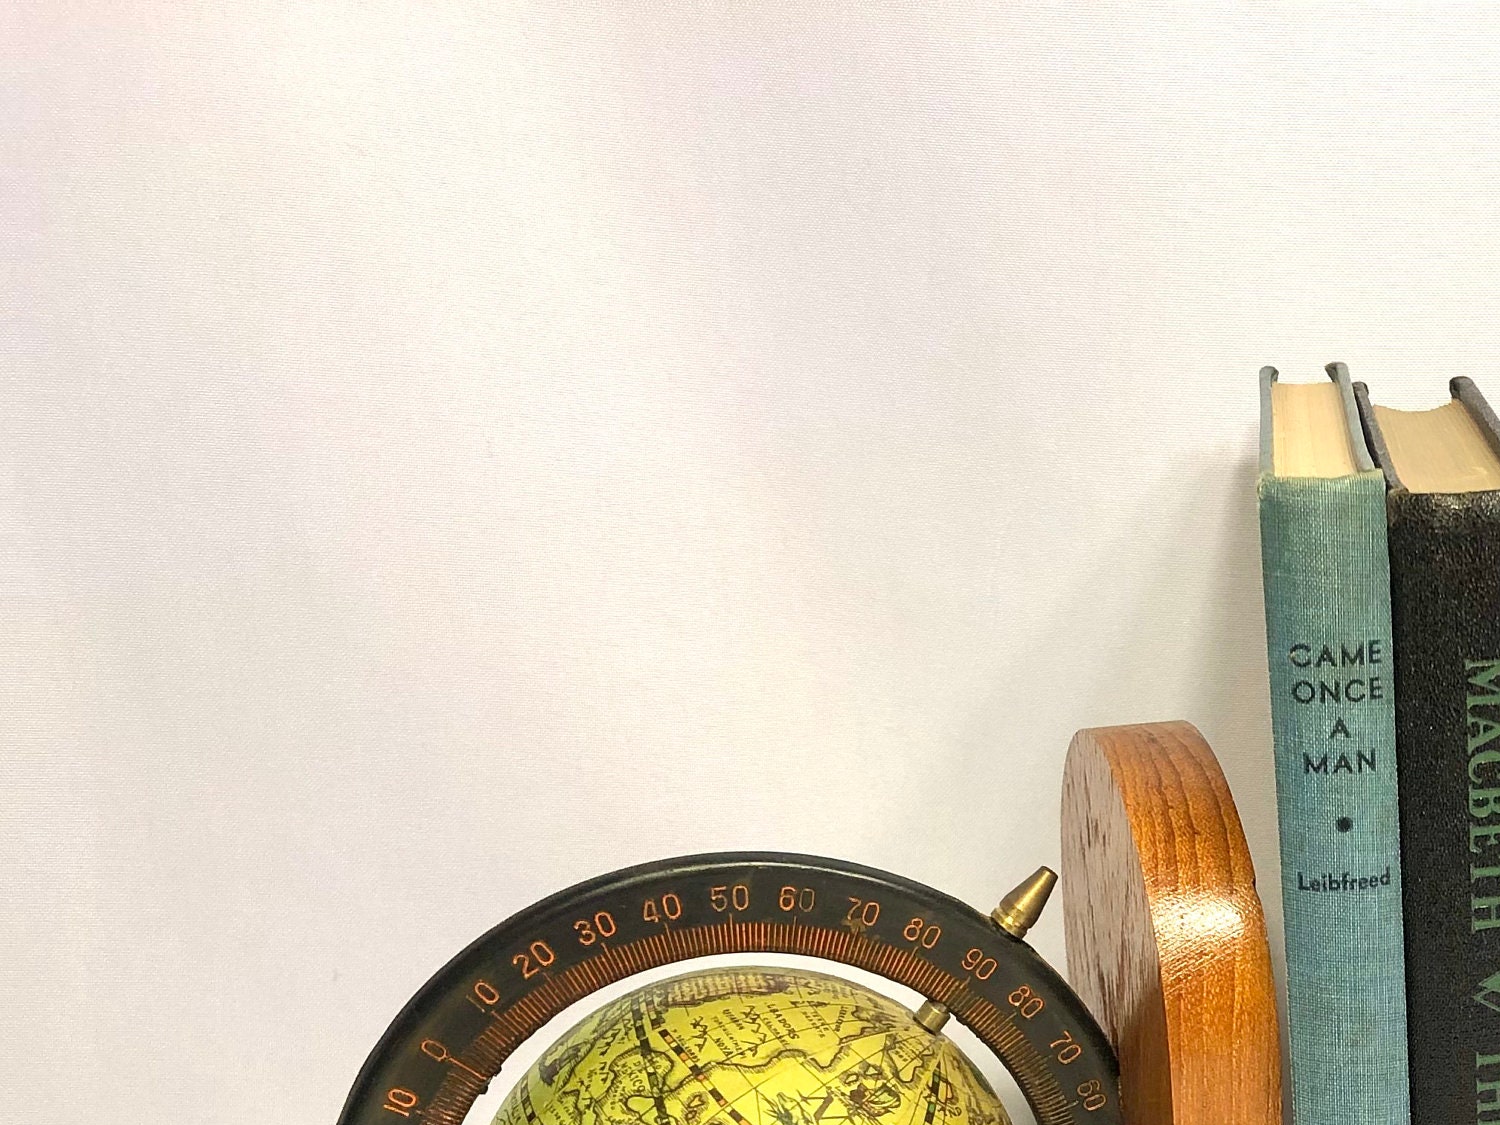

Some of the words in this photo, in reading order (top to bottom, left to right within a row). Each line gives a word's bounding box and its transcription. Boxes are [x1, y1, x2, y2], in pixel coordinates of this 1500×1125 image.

[1290, 639, 1383, 668] CAME
[1291, 676, 1384, 704] ONCE
[1330, 716, 1350, 738] A
[1304, 748, 1377, 775] MAN
[1297, 866, 1391, 893] Leibfreed
[643, 893, 682, 923] 40
[711, 884, 749, 912] 50
[778, 886, 815, 912] 60
[847, 897, 880, 926] 70
[573, 911, 617, 946] 30
[903, 917, 942, 950] 80
[512, 941, 556, 979] 20
[961, 948, 998, 981] 90
[466, 980, 500, 1012] 10
[1007, 984, 1045, 1019] 80
[421, 1039, 447, 1062] 0
[1049, 1030, 1081, 1066] 70
[383, 1087, 418, 1117] 10
[1076, 1079, 1107, 1112] 60
